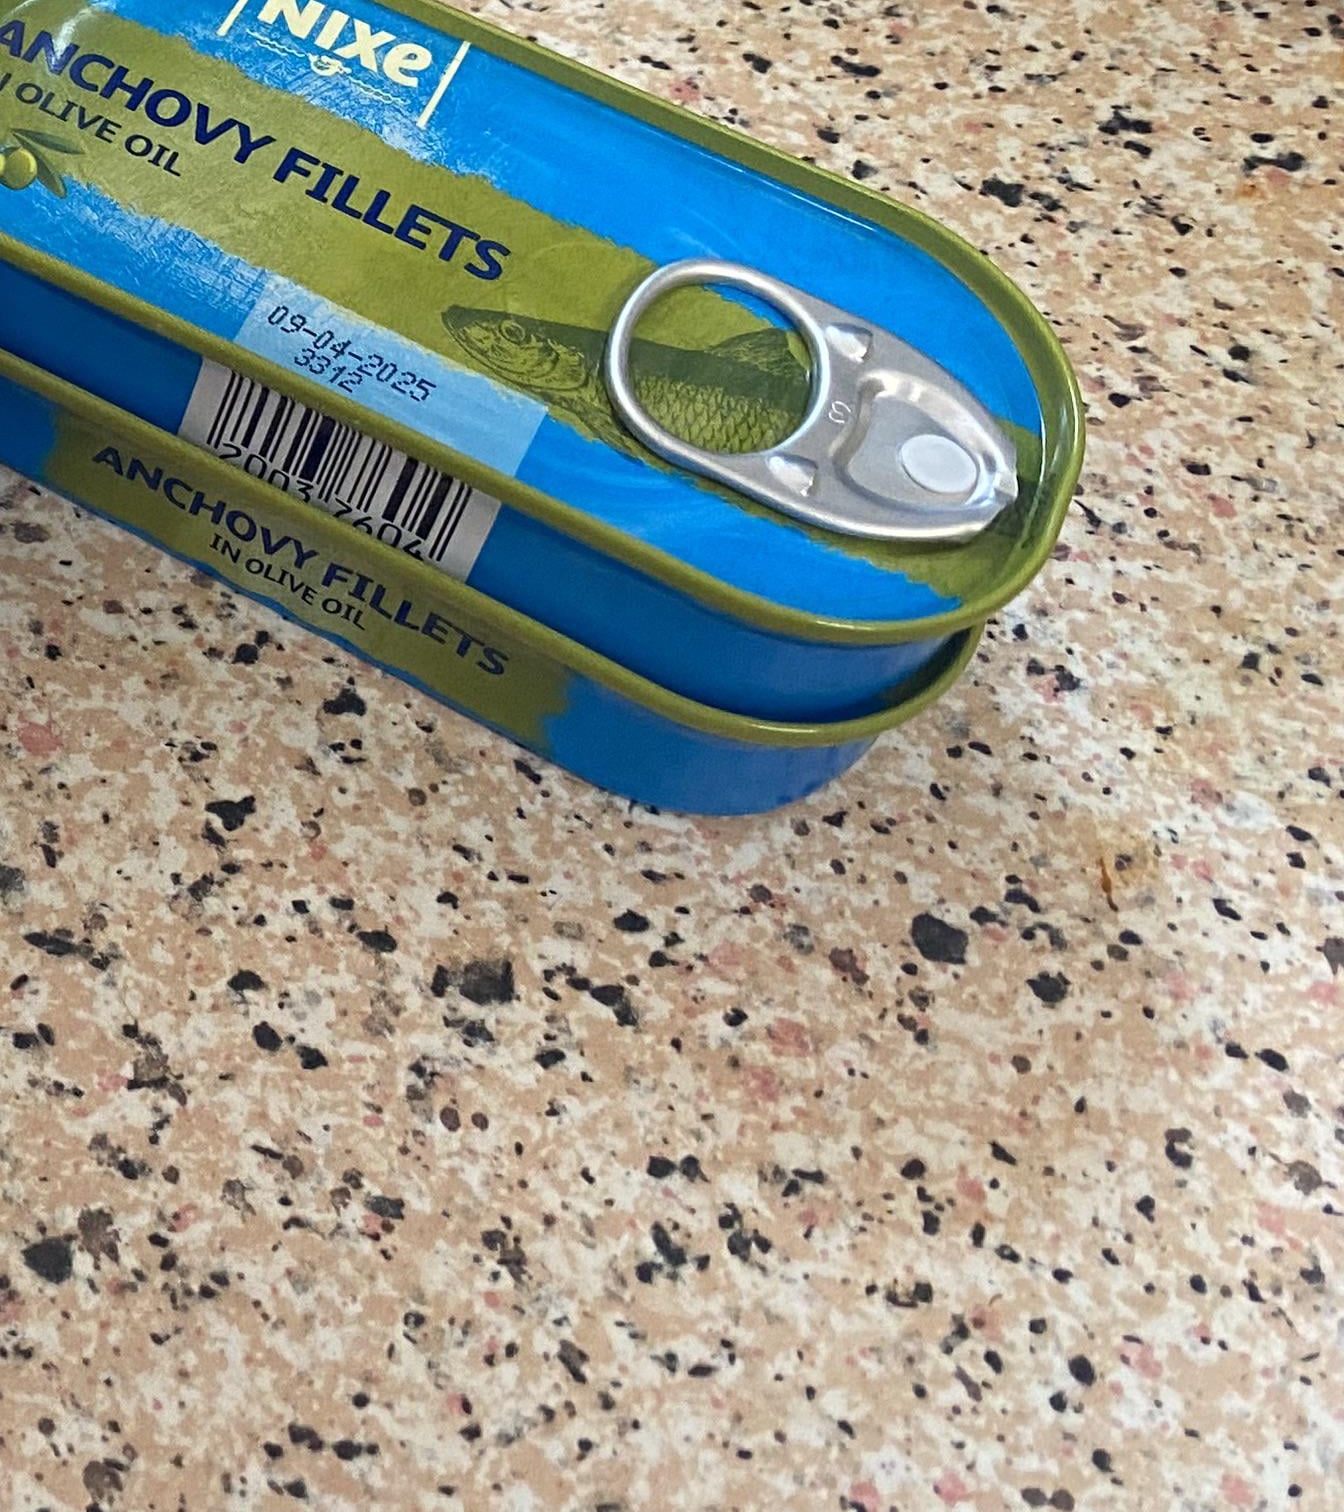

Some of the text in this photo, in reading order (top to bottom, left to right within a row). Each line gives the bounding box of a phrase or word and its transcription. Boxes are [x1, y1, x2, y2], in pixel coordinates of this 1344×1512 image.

[15, 83, 123, 145] OLIVE
[125, 133, 184, 178] OIL
[272, 147, 512, 282] FILLETS
[267, 305, 437, 402] 09-04-2025
[294, 347, 363, 393] 3312
[92, 445, 510, 677] ANCHOVY FILLETS
[209, 533, 366, 631] IN OLIVE OIL
